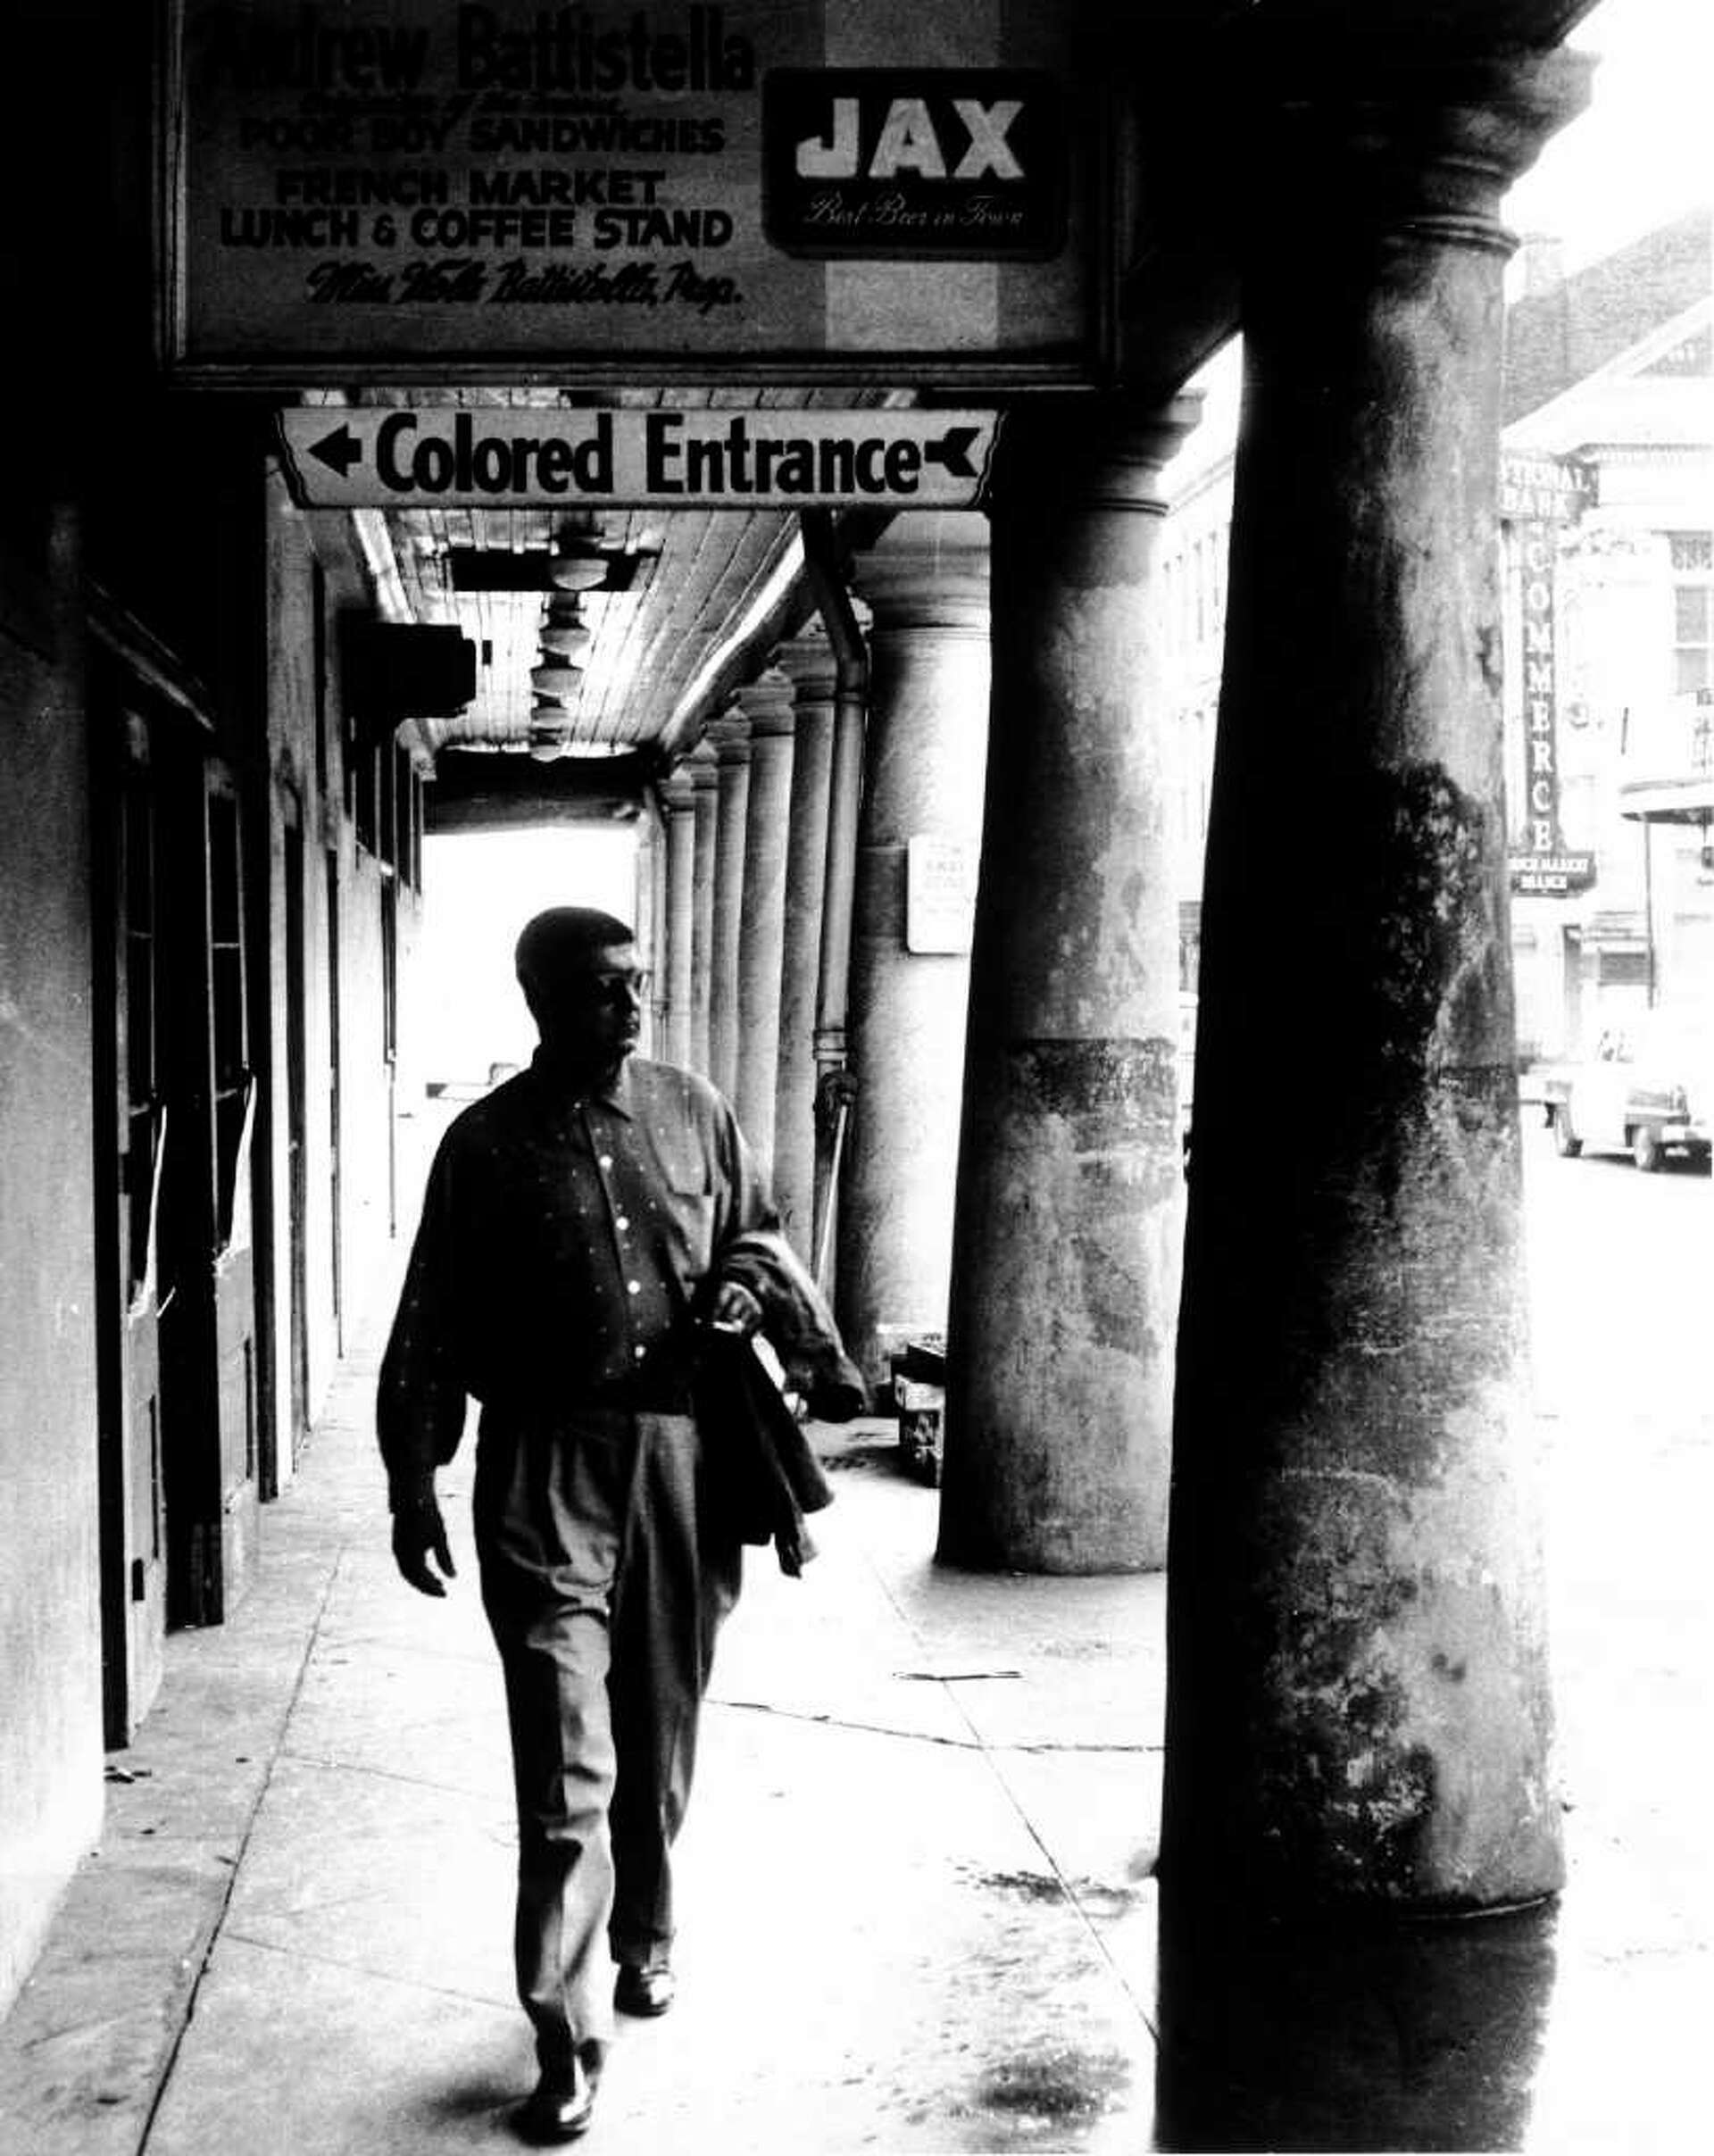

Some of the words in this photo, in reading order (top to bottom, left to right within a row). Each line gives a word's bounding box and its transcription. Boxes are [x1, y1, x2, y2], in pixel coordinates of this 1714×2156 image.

[457, 4, 754, 91] Battistella
[239, 117, 353, 153] POOR
[370, 117, 453, 153] BOY
[469, 118, 725, 153] SANDWICHES
[796, 98, 1025, 179] JAX
[276, 169, 448, 205] FRENCH
[469, 169, 666, 205] MARKET
[220, 209, 359, 247] LUNCH
[372, 214, 395, 246] &
[411, 209, 576, 248] COFFEE
[594, 209, 734, 249] STAND
[376, 412, 614, 494] Colored
[645, 412, 920, 494] Entrance
[1527, 539, 1553, 851] COMMERCE
